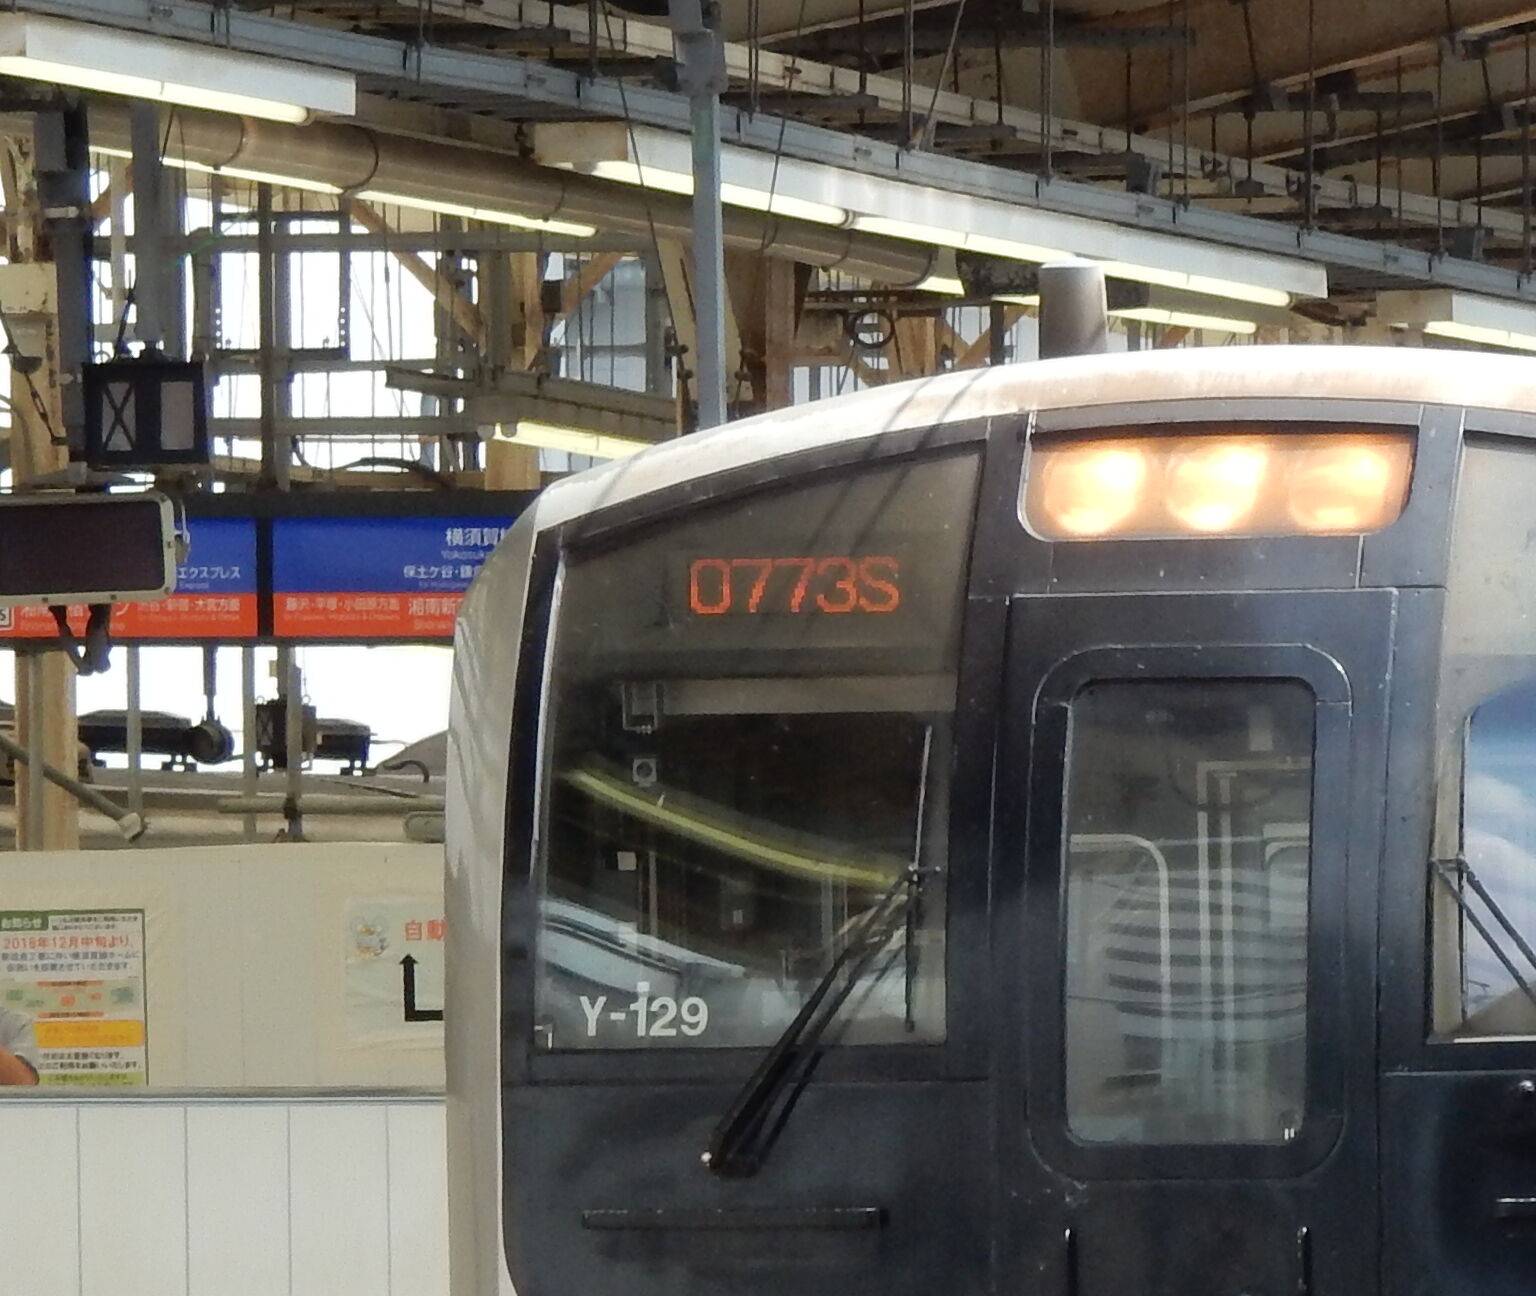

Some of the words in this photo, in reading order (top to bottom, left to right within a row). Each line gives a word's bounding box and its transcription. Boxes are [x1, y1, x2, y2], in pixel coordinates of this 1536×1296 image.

[178, 566, 241, 579] エクスプレス
[690, 557, 900, 614] 0773S
[579, 996, 709, 1037] Y-129
